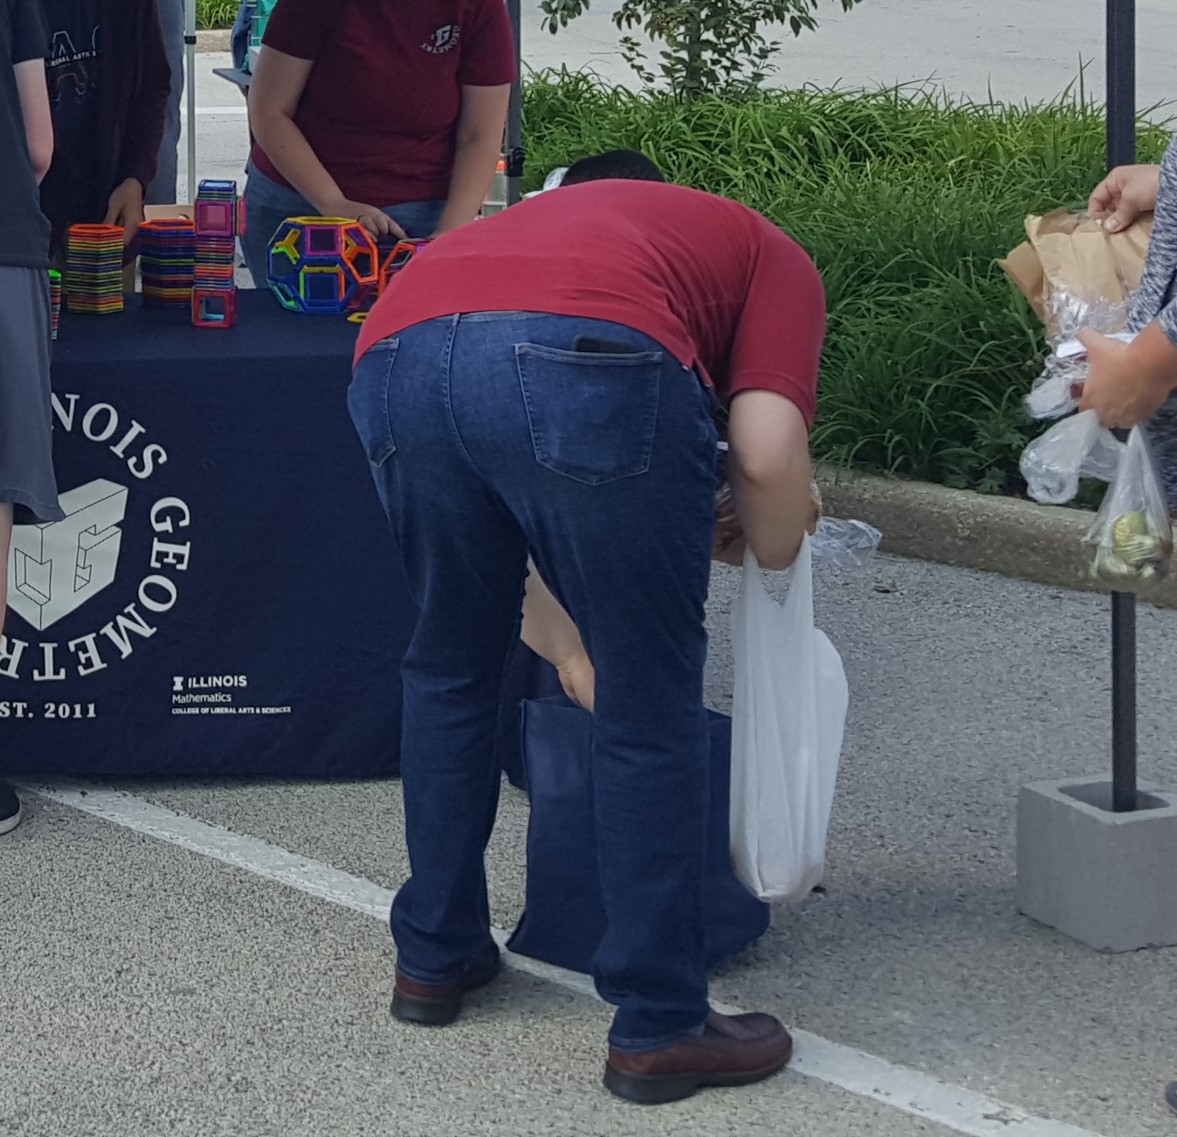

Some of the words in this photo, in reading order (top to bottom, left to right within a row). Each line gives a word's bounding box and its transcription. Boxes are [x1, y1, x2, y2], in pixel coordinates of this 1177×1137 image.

[51, 392, 168, 479] NOIS
[188, 675, 248, 688] ILLINOIS
[172, 692, 232, 704] Mathematics
[44, 702, 97, 719] 2011
[171, 707, 200, 715] COLLEGE
[261, 706, 291, 714] SCIENCES
